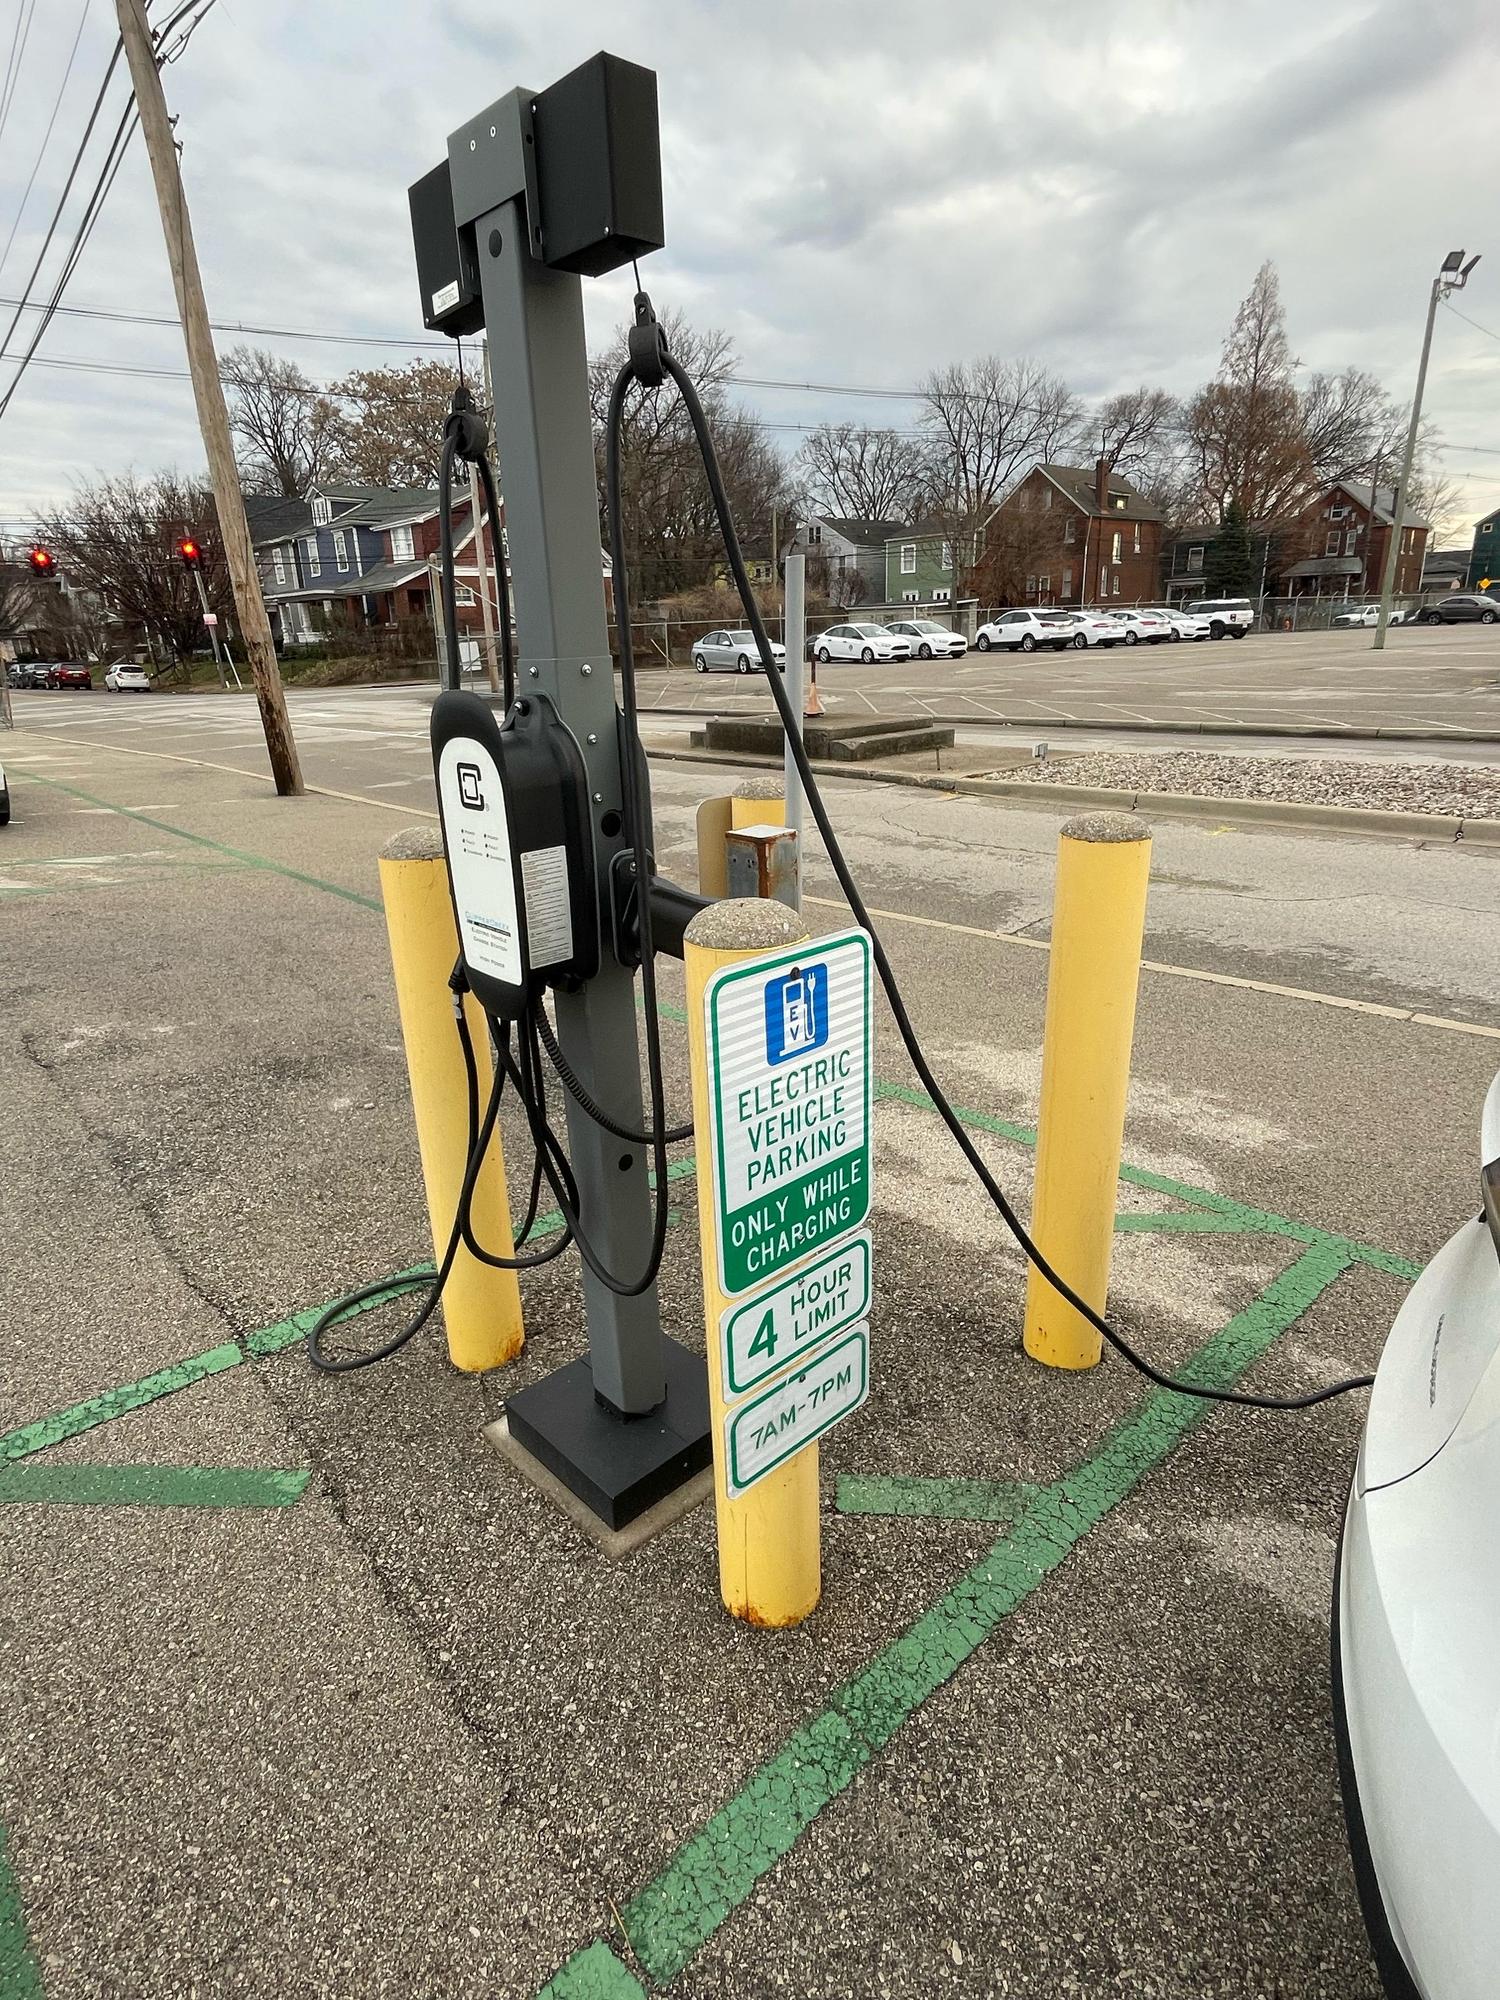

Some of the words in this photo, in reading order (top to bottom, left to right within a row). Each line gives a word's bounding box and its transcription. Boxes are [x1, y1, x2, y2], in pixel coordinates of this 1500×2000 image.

[738, 1049, 851, 1122] ELECTRIC
[748, 1085, 845, 1152] VEHICLE
[748, 1121, 846, 1191] PARKING
[732, 1196, 789, 1247] ONLY
[803, 1158, 861, 1204] WHILE
[747, 1197, 851, 1272] CHARGING
[791, 1262, 851, 1315] HOUR
[794, 1289, 849, 1341] LIMIT
[748, 1308, 778, 1359] 4
[750, 1364, 851, 1450] 7AM-7PM
